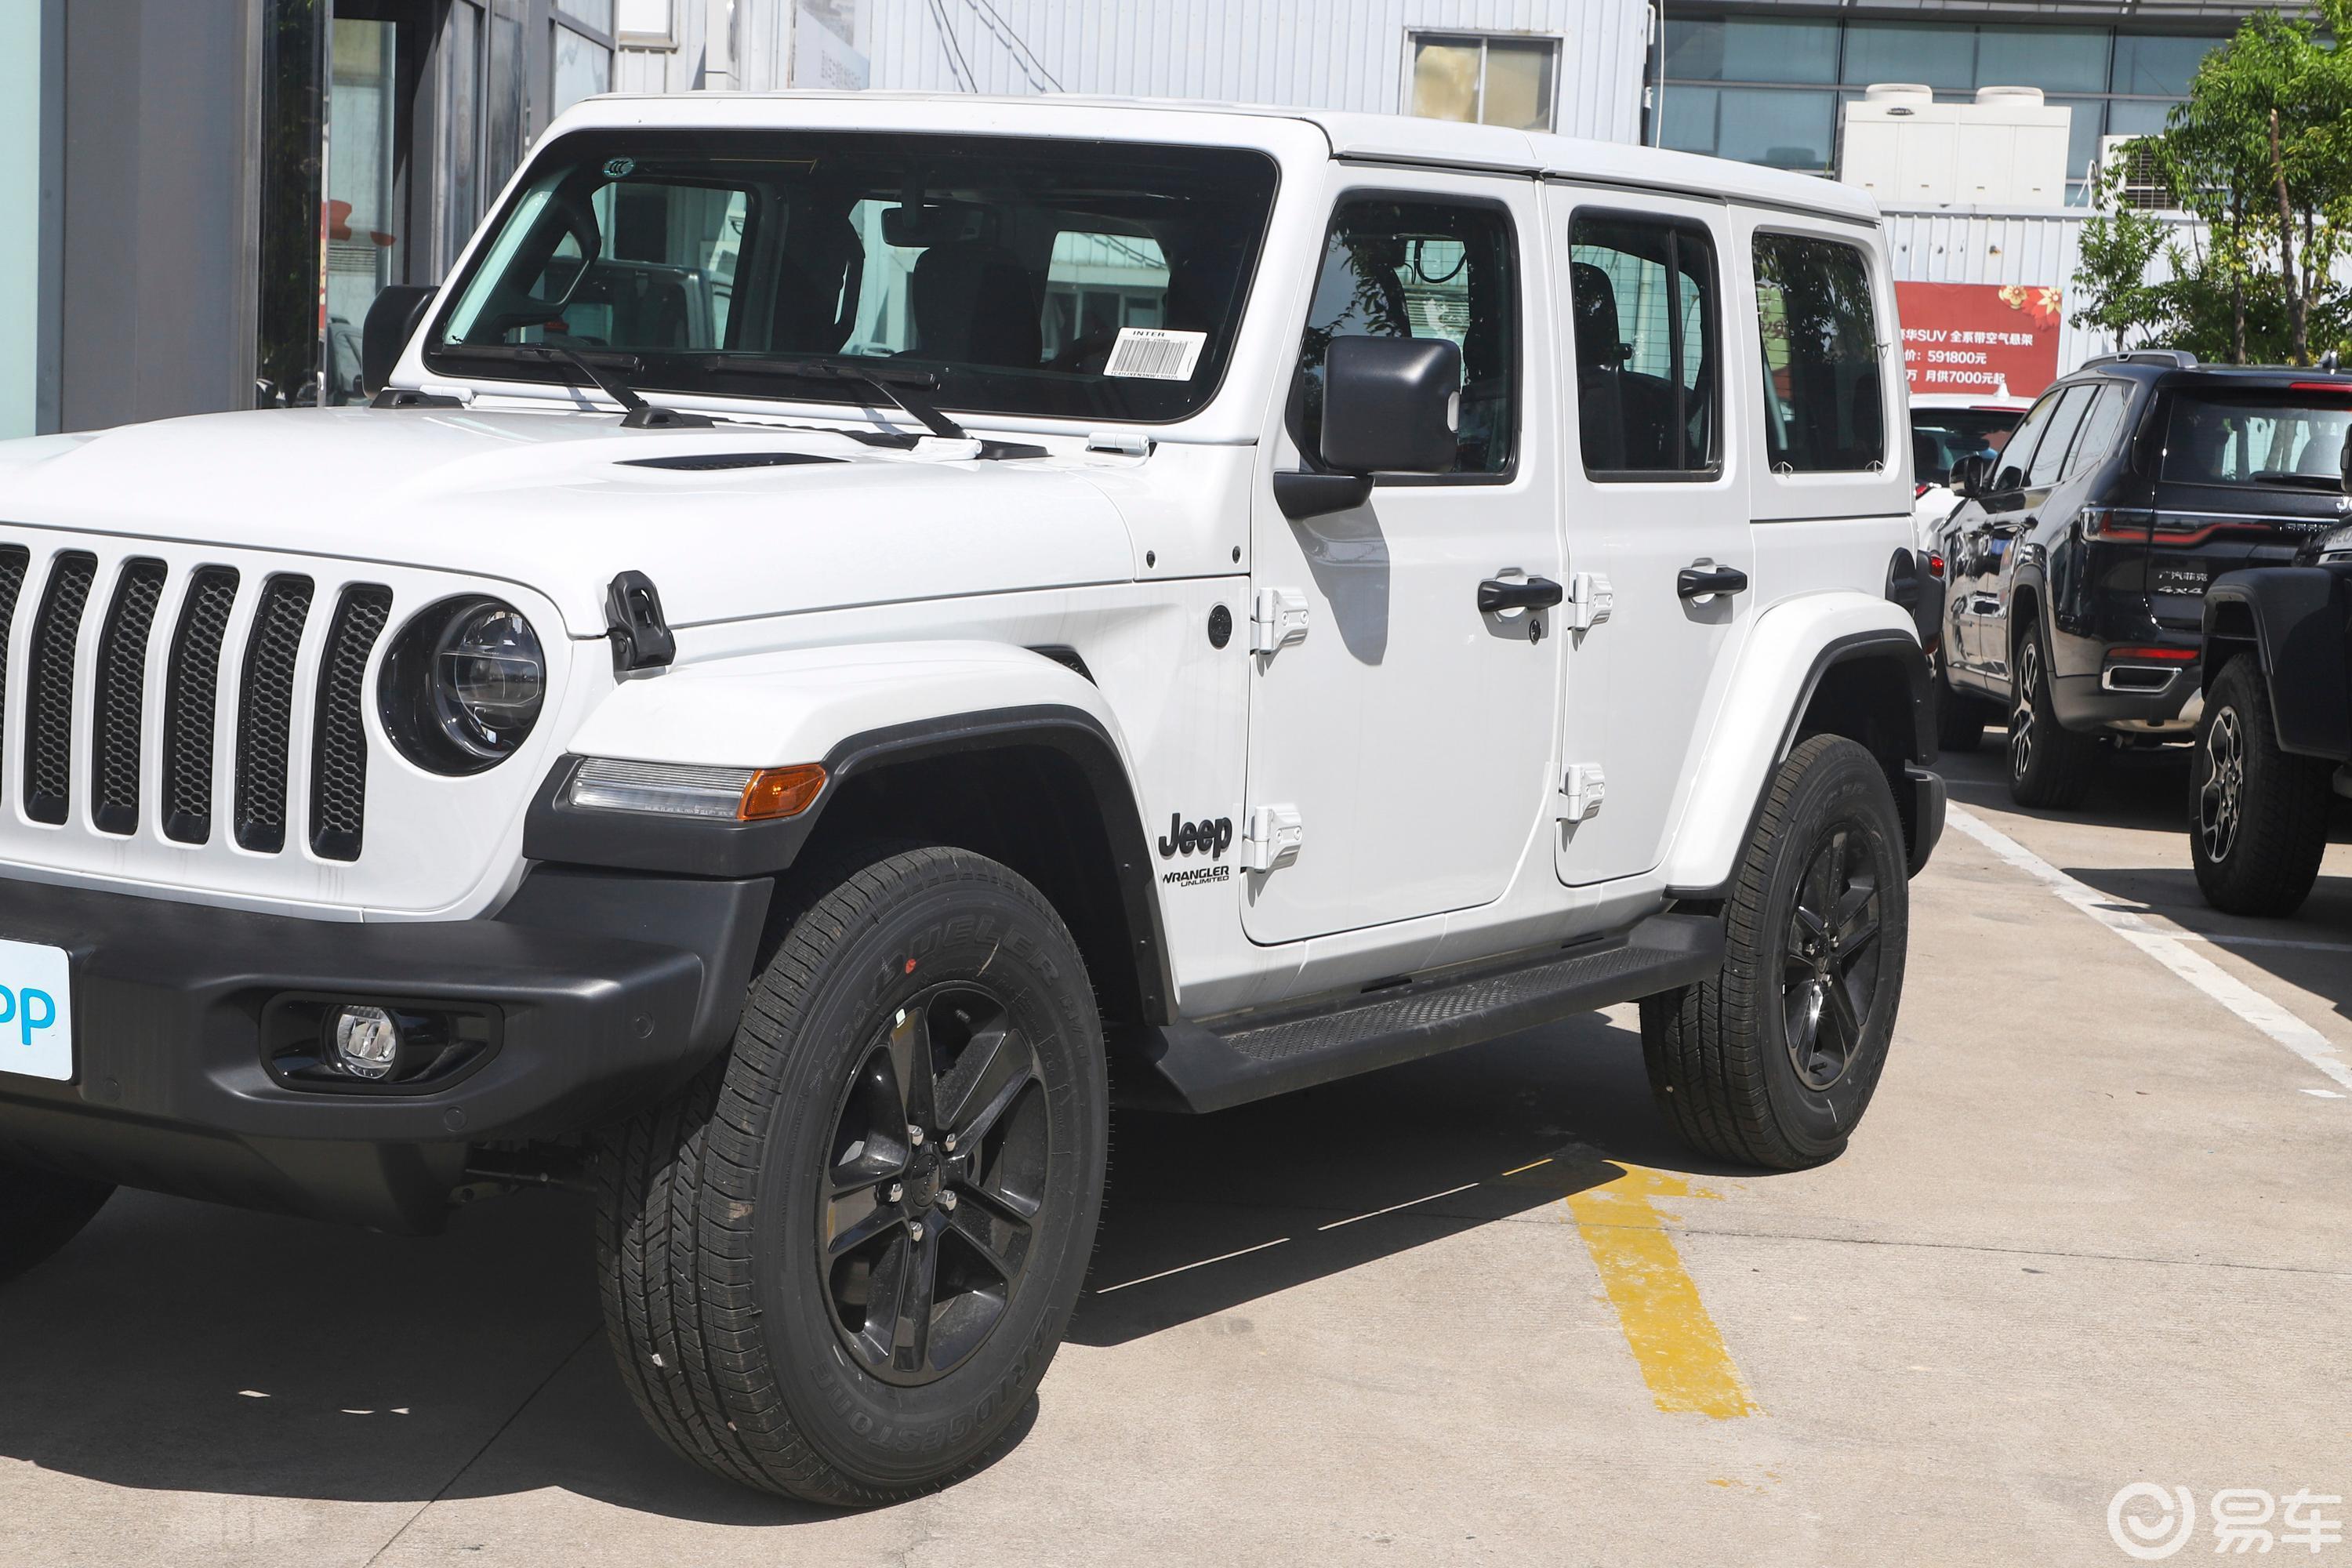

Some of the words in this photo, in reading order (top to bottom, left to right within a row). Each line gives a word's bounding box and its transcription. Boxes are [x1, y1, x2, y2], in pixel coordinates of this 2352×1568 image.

[1158, 812, 1232, 859] Jeep
[1162, 866, 1229, 884] WRANGLER
[1180, 875, 1229, 887] UNLIMITED
